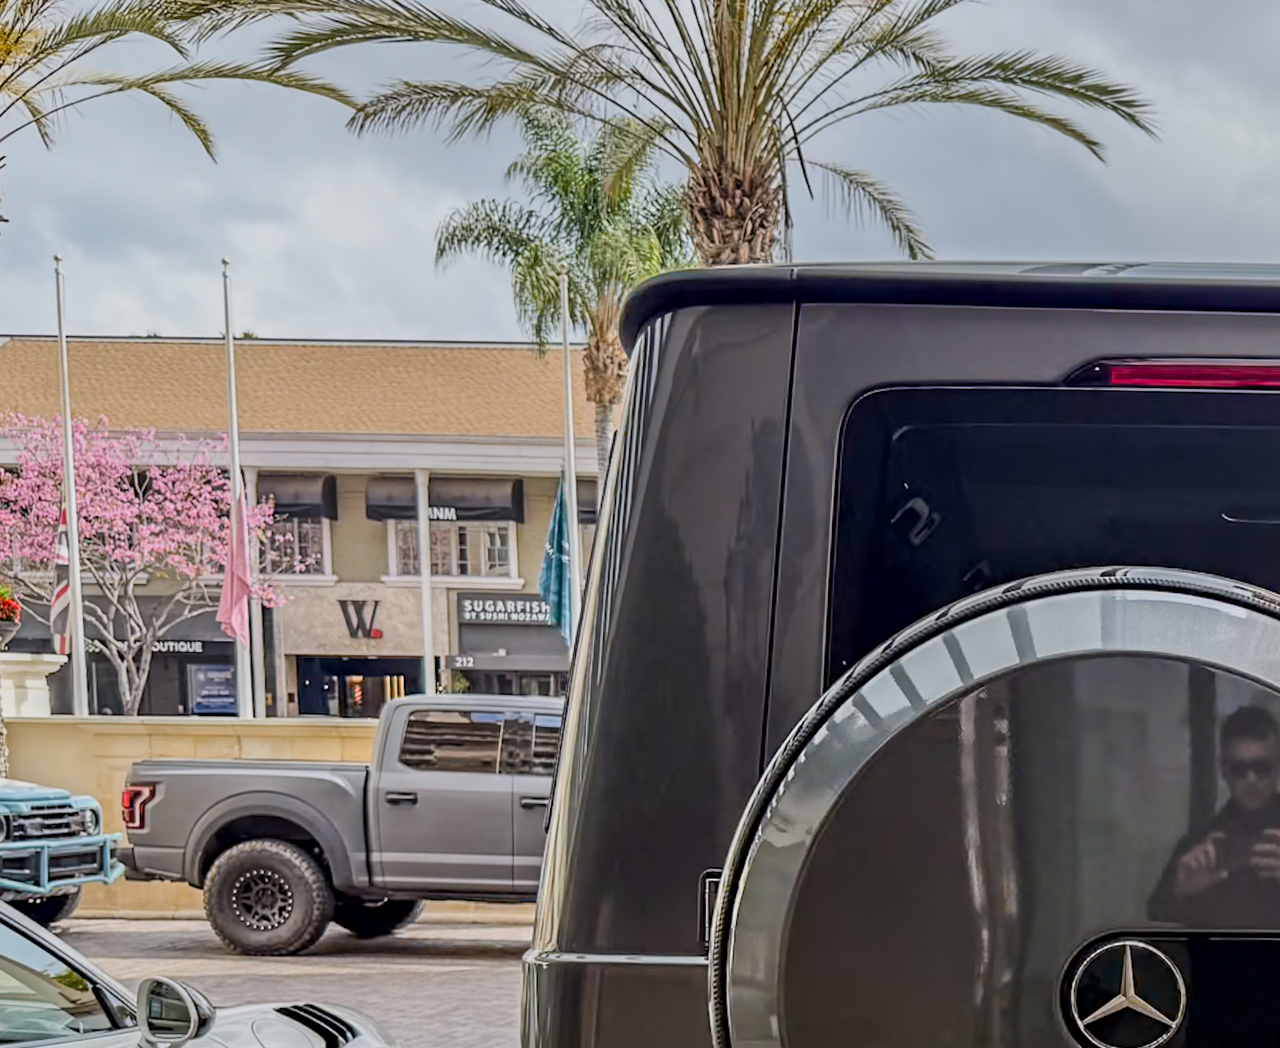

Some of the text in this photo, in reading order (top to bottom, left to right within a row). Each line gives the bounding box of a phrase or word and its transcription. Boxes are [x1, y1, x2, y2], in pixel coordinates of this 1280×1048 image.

[480, 612, 508, 621] SUSHI
[152, 641, 203, 653] OUTIQUE
[454, 657, 474, 667] 212
